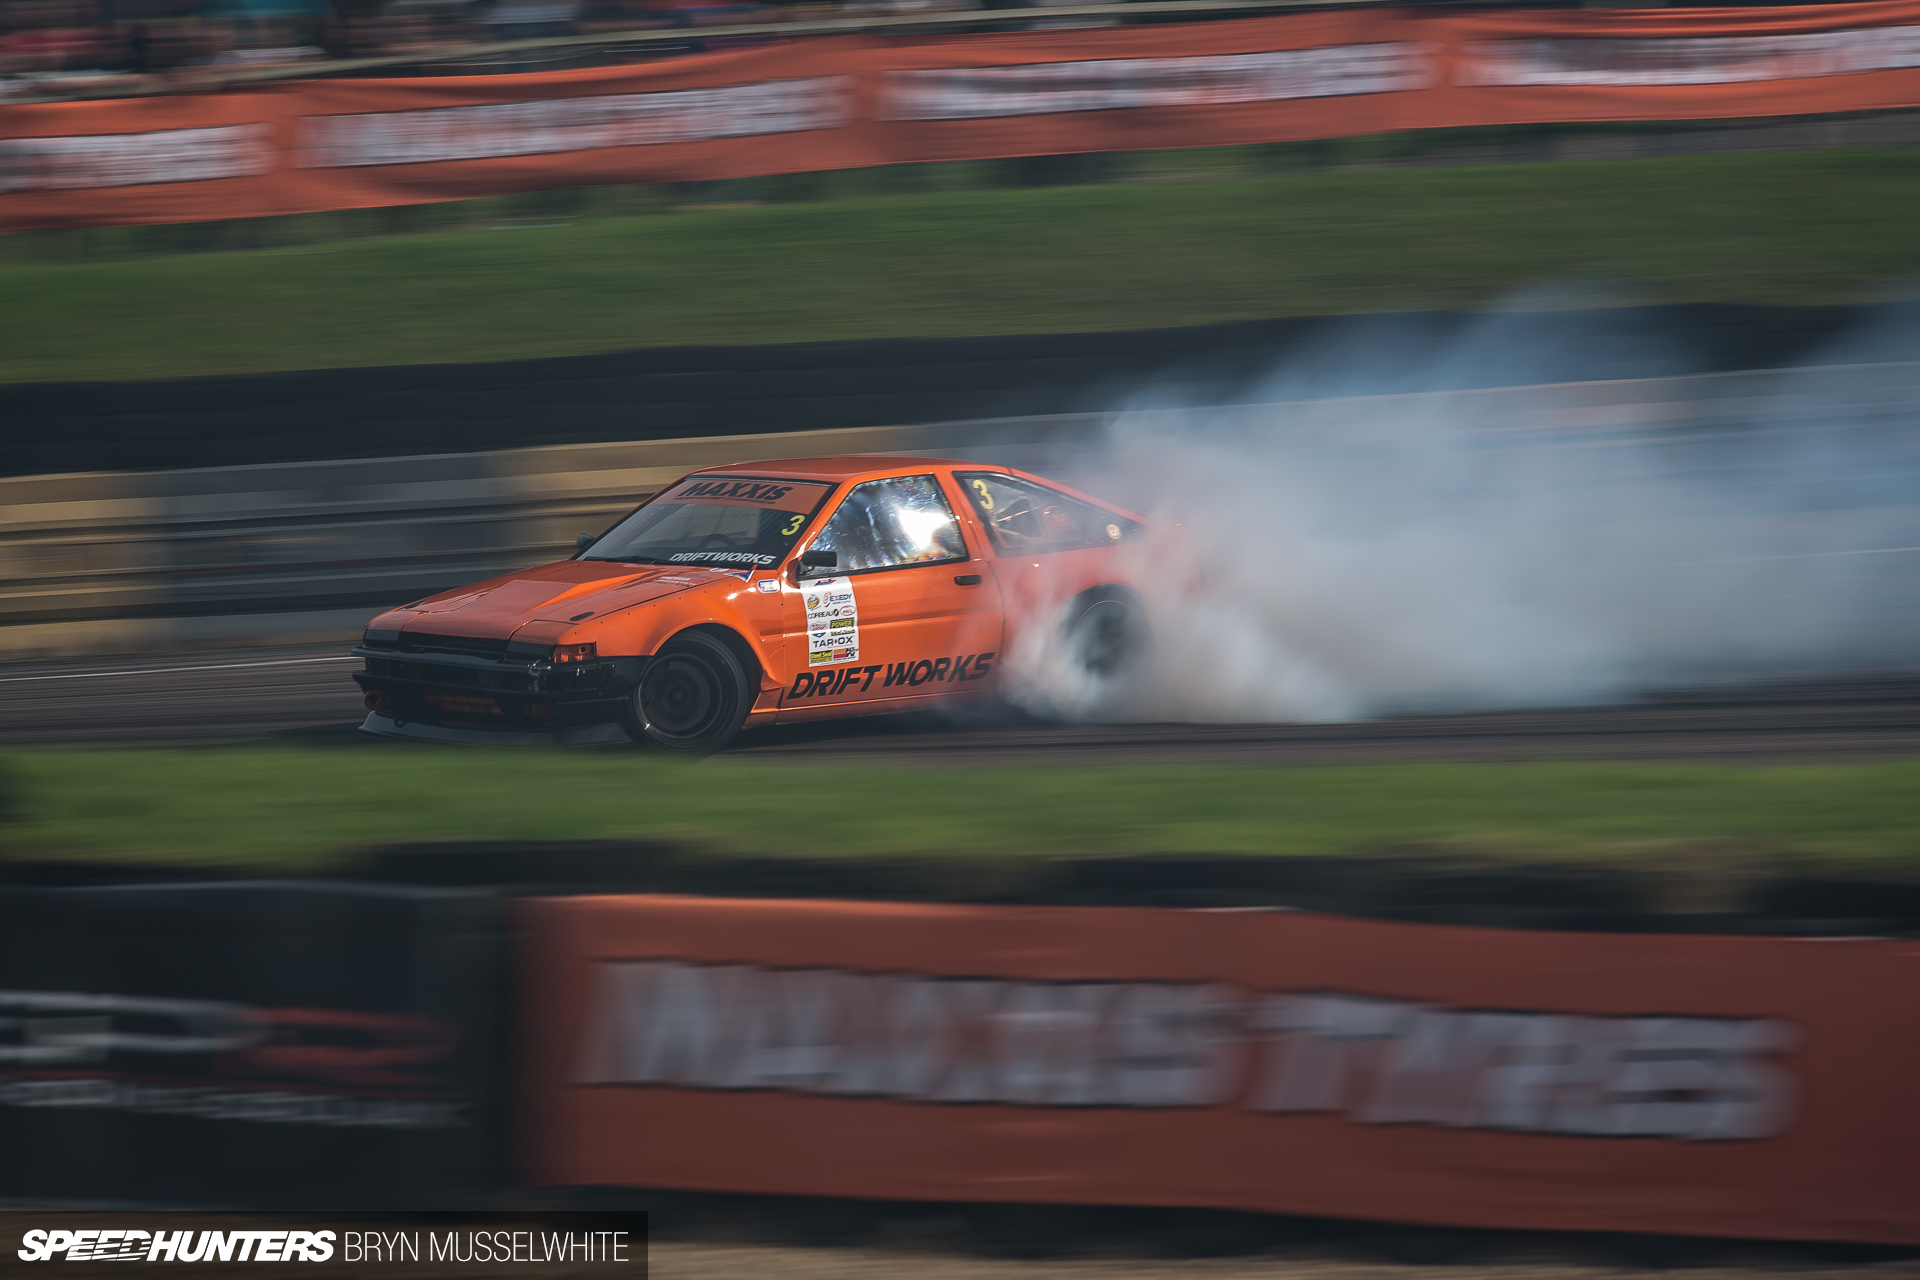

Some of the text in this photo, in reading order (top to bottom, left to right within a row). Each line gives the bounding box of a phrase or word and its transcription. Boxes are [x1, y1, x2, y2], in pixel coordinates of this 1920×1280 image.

[676, 482, 794, 501] MAXXIS
[972, 479, 995, 510] 3
[781, 514, 806, 536] 3
[668, 551, 778, 565] DRIFTWORKS
[786, 652, 997, 700] DRIFT WORKS
